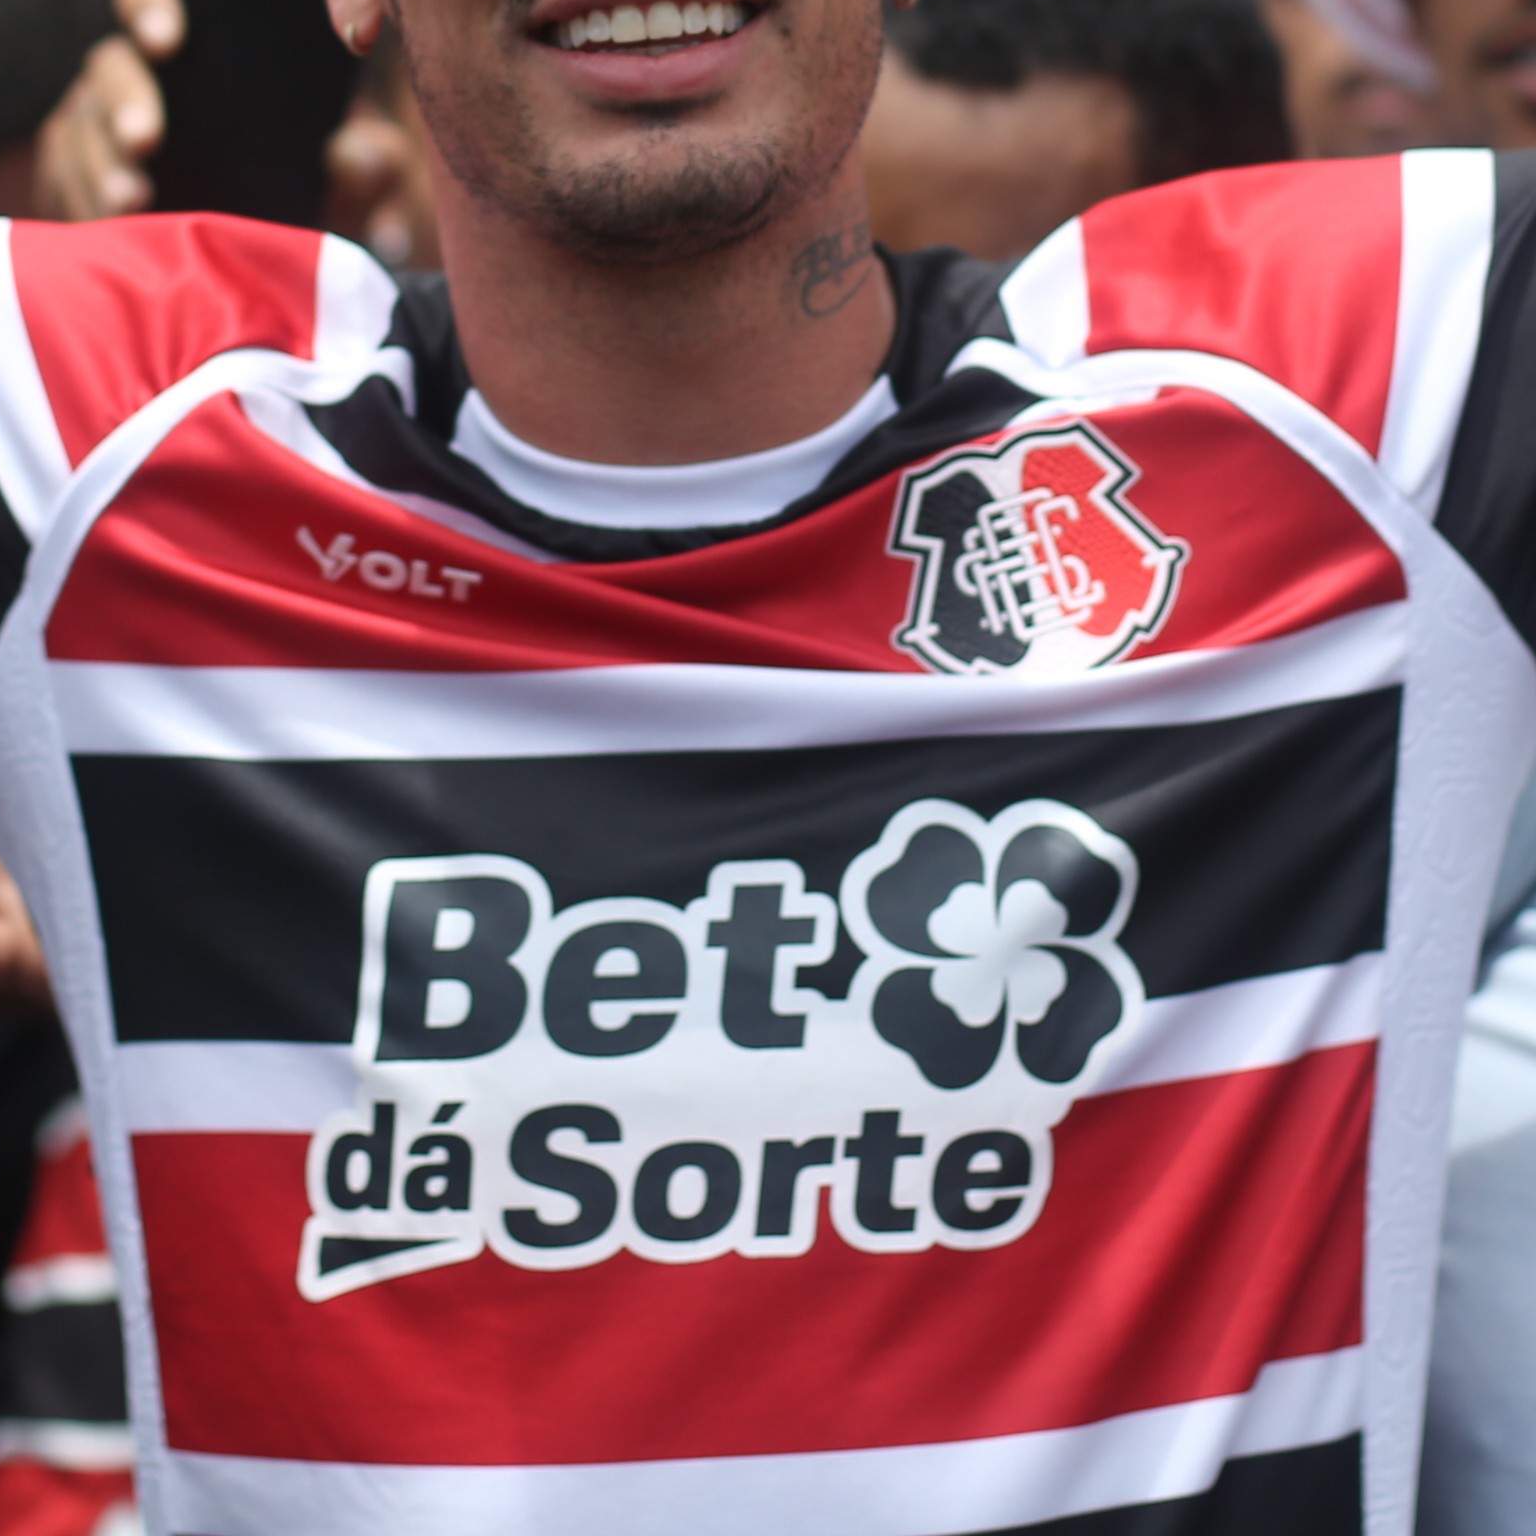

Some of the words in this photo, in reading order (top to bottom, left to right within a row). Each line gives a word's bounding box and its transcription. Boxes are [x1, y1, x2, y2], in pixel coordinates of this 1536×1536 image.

[296, 525, 483, 601] VOLT
[374, 875, 814, 1063] Bet
[325, 1101, 473, 1211] dá
[502, 1104, 1033, 1249] Sorte
